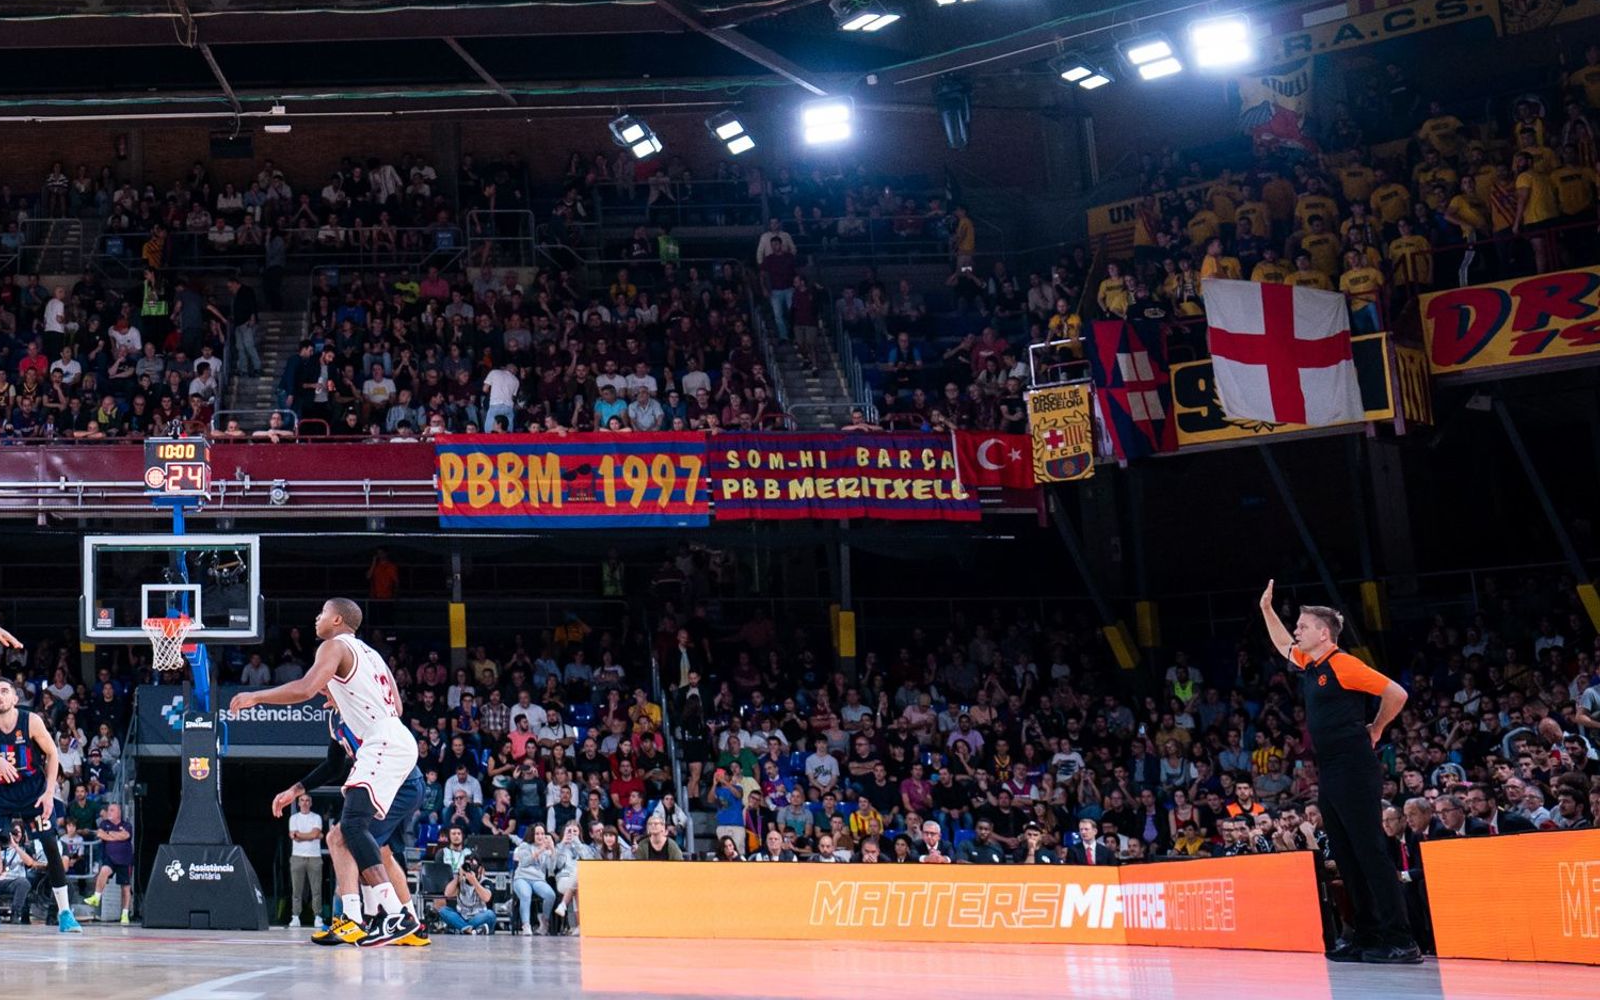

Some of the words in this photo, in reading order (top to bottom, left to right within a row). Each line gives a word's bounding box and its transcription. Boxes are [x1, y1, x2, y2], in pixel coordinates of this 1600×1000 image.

[726, 450, 827, 470] SOM-HI
[856, 447, 955, 471] BARÇA
[169, 466, 202, 490] 24
[439, 452, 563, 509] PBBM
[598, 454, 702, 508] 1997
[809, 881, 1061, 928] MATTERS
